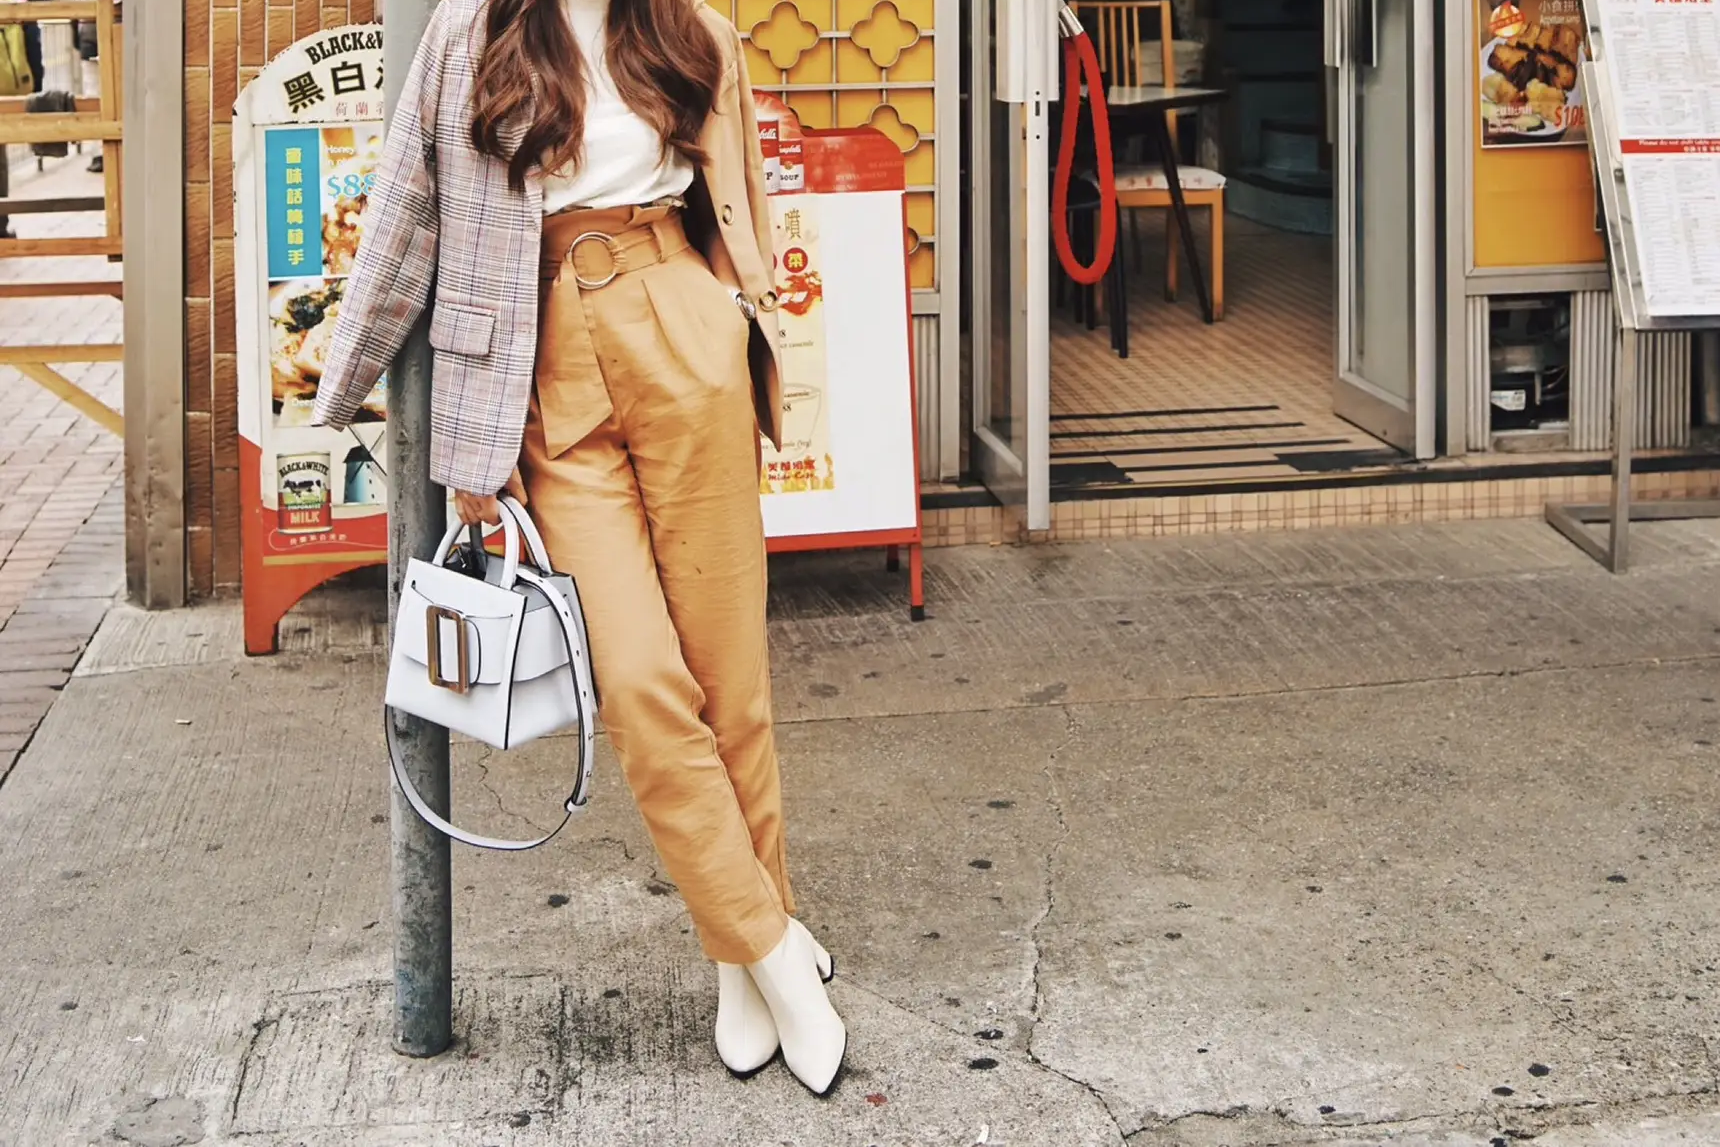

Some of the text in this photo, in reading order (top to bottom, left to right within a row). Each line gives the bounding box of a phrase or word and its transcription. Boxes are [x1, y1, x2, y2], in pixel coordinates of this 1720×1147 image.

[1539, 0, 1578, 13] 小食拼
[283, 58, 383, 113] 黑白
[290, 511, 320, 524] MILK
